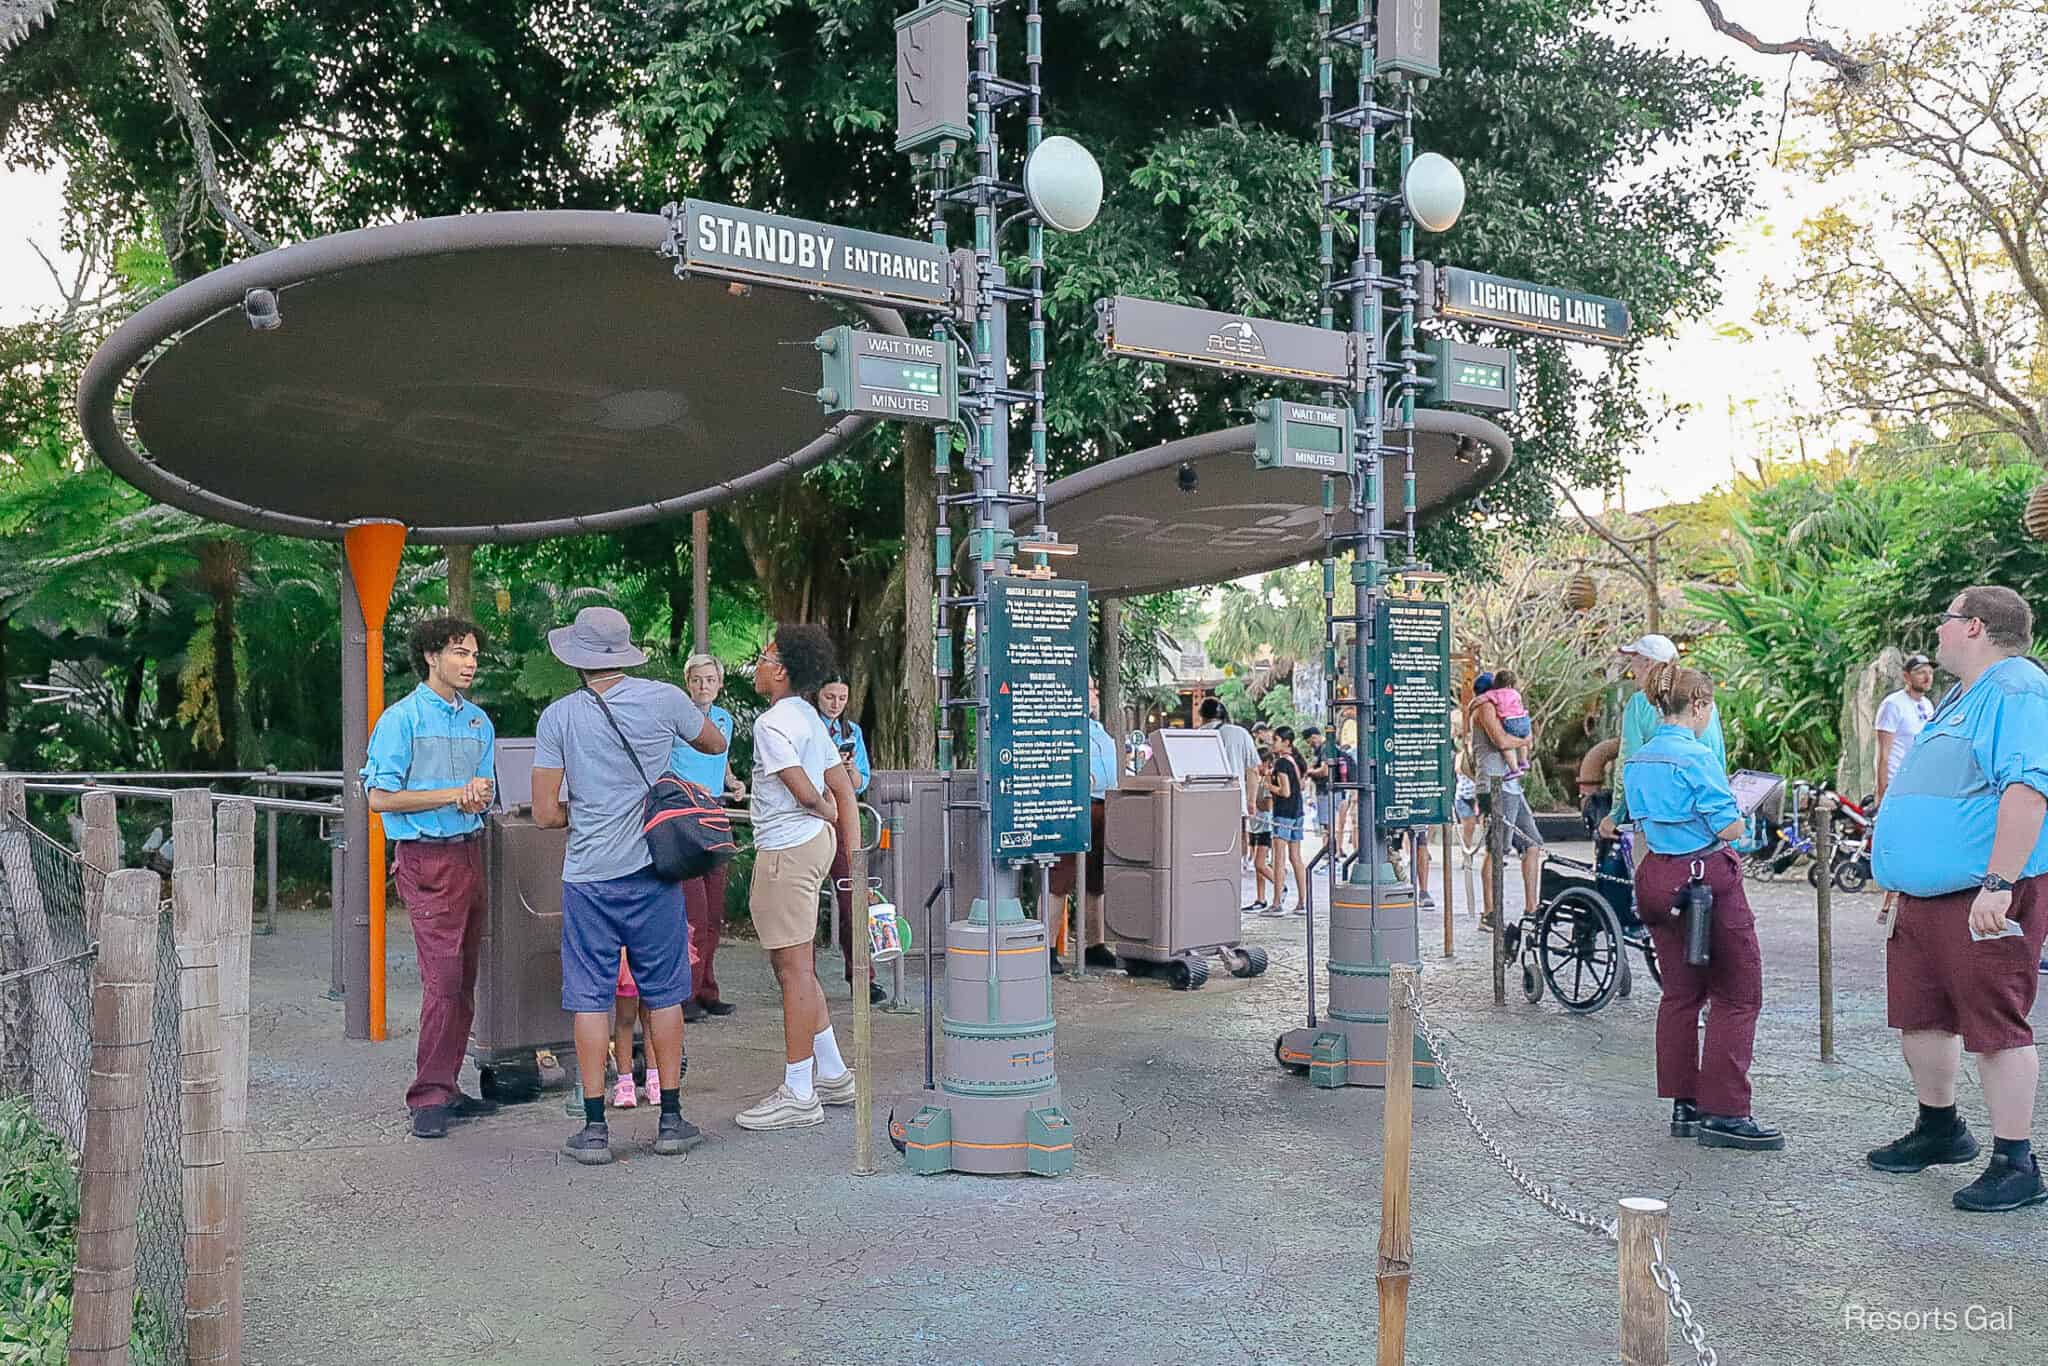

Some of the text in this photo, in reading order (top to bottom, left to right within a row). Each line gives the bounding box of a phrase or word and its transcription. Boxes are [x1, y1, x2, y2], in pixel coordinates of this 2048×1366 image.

[698, 214, 939, 284] STANDBY ENTRANCE
[1470, 280, 1606, 329] LIGHTNING LANE
[868, 338, 933, 357] WAIT TIME
[872, 394, 929, 411] MINUTES
[1291, 407, 1337, 424] WAIT TIME
[1296, 453, 1335, 466] MINUTES
